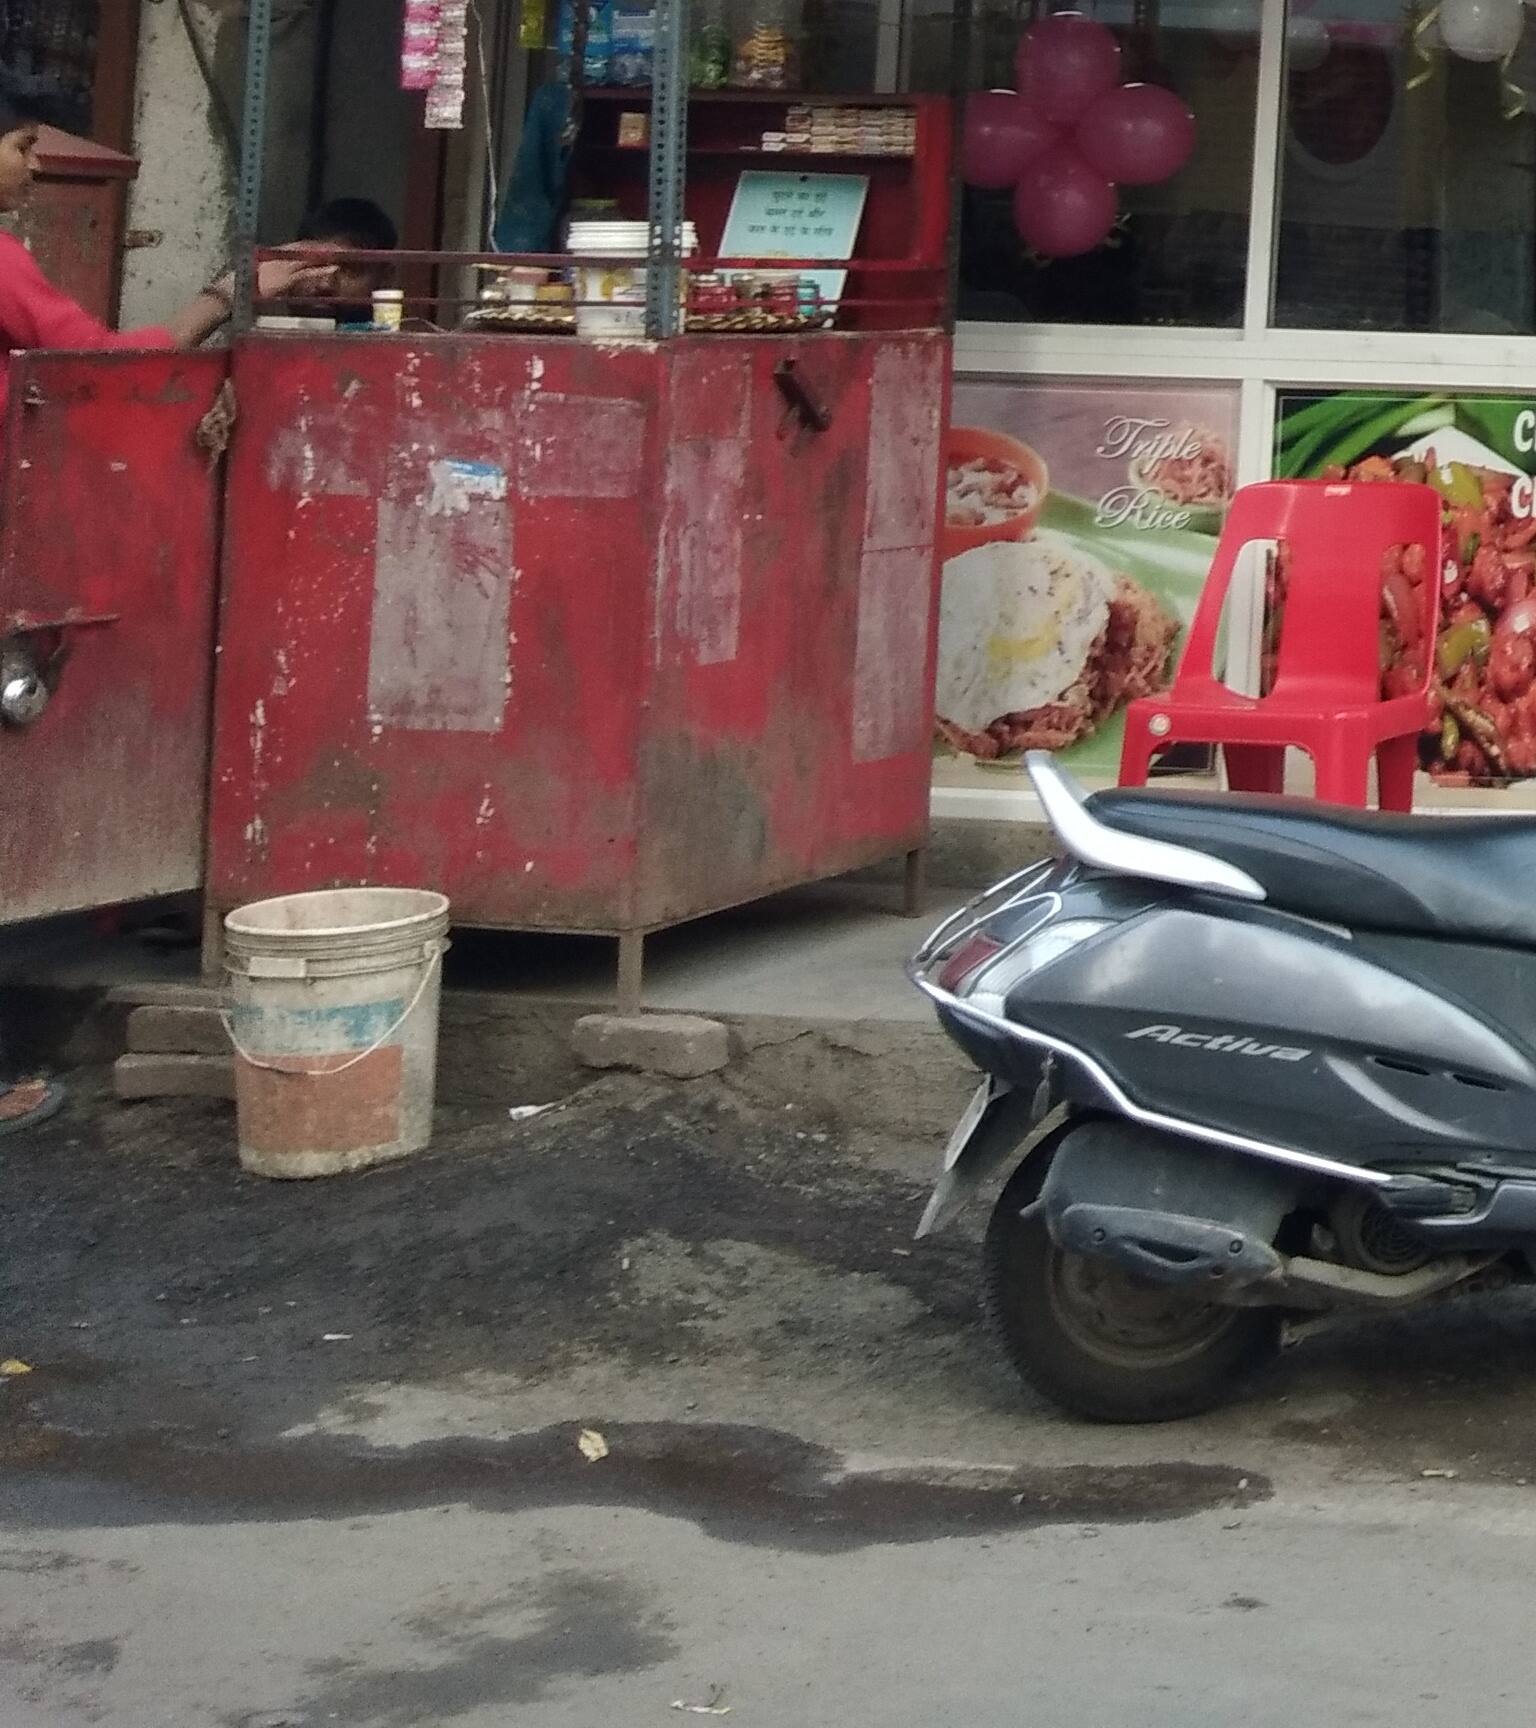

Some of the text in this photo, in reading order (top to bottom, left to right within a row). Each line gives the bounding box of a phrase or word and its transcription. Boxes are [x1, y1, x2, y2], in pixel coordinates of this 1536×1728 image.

[1096, 414, 1202, 476] Triple
[1095, 484, 1193, 532] Rice
[1124, 1024, 1313, 1062] Activa
